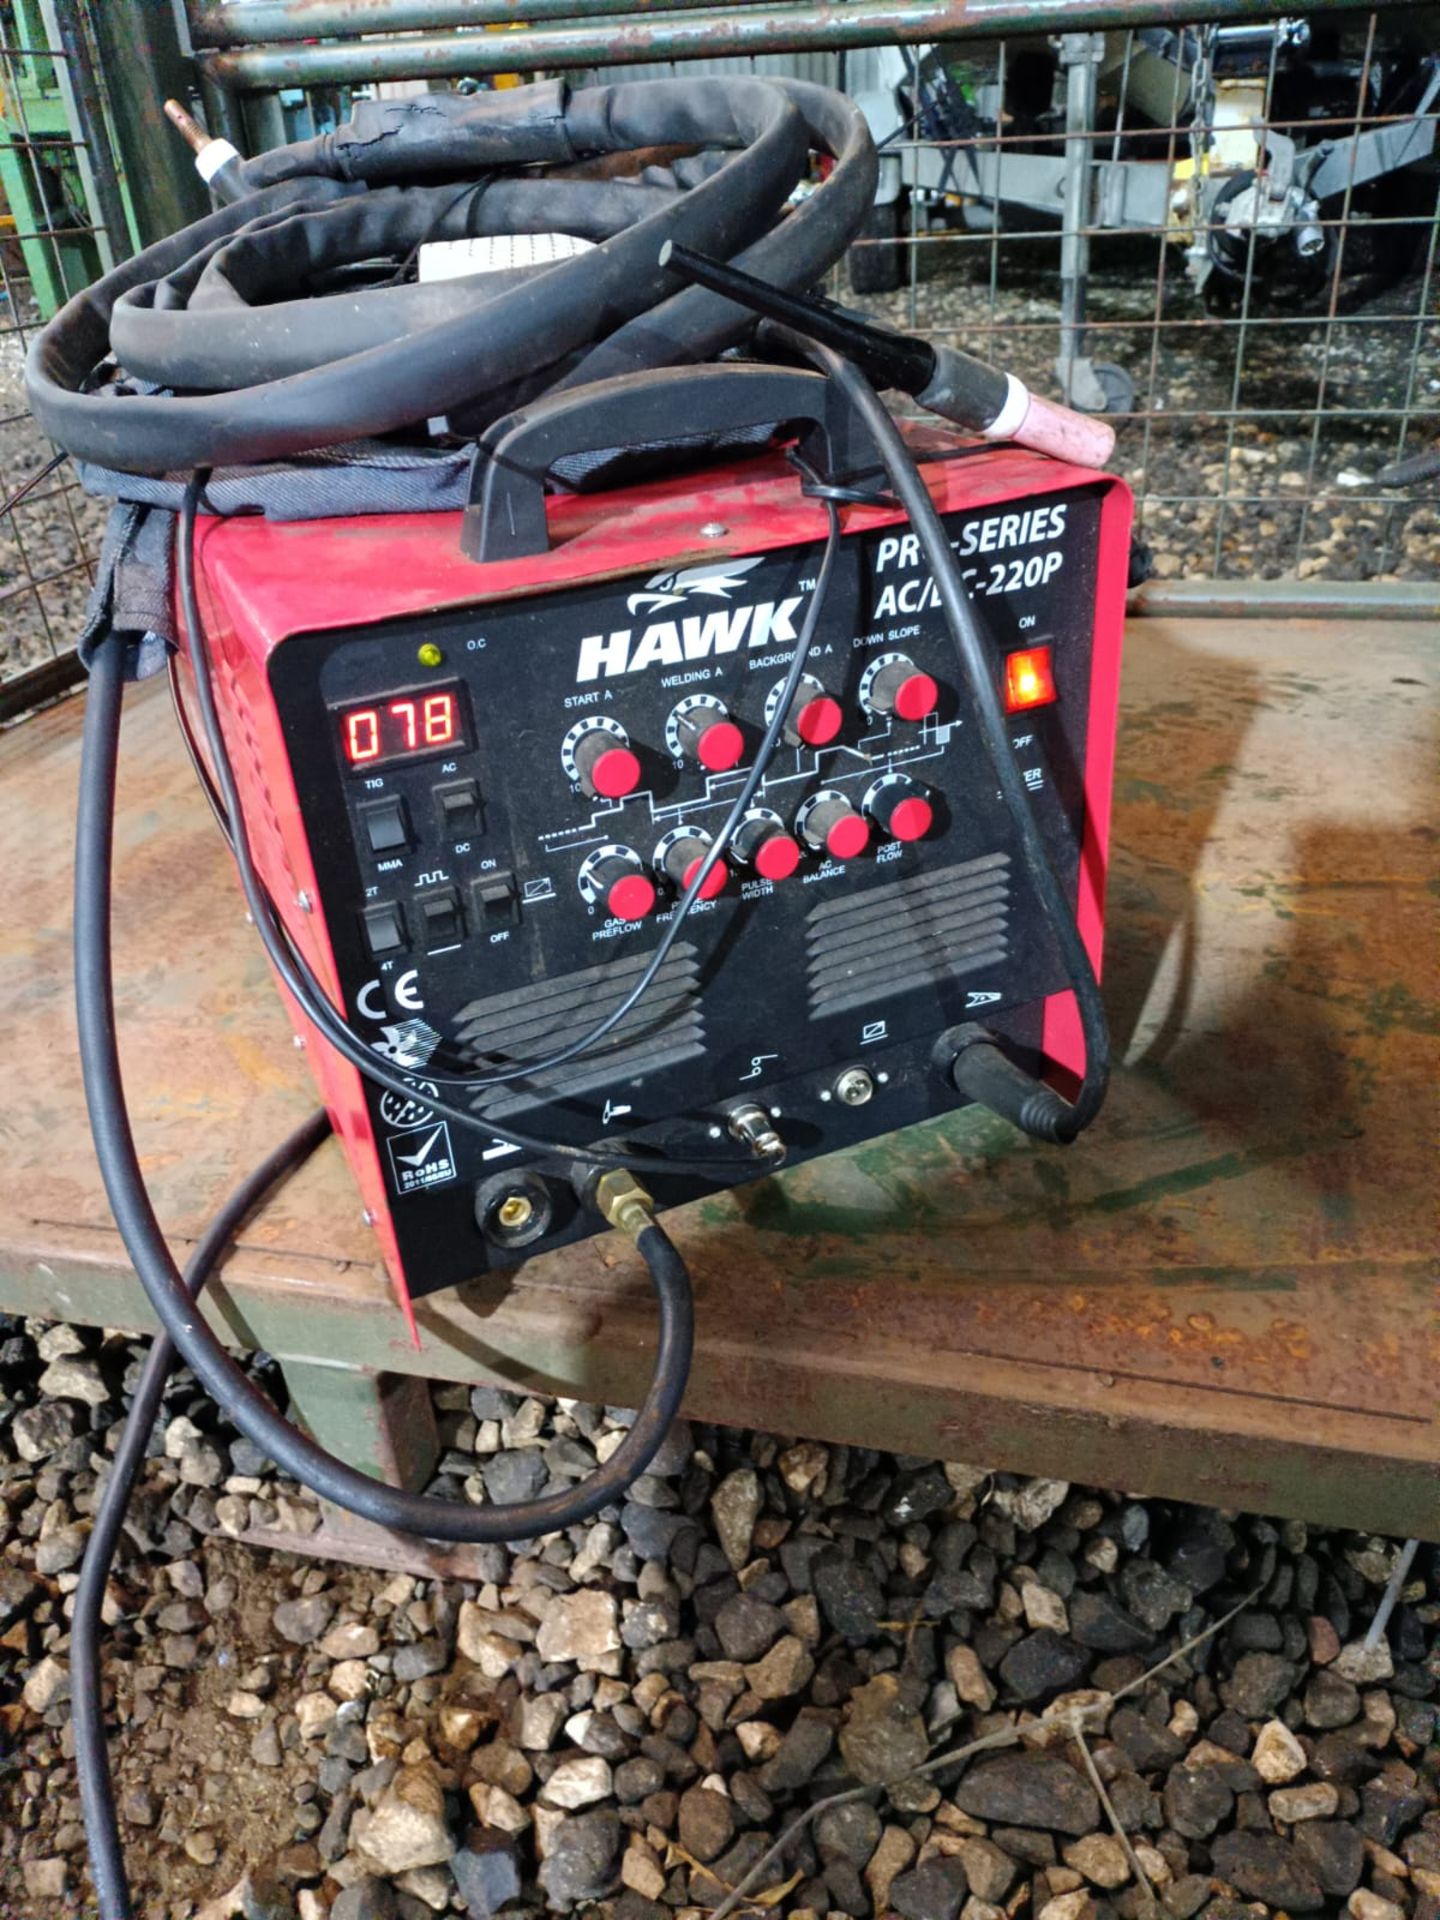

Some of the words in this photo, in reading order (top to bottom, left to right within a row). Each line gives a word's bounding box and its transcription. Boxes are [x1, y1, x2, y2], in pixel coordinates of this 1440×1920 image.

[876, 503, 1067, 573] PR-SERIES
[1018, 615, 1036, 629] ON
[576, 596, 804, 683] HAWK
[798, 578, 816, 592] TM
[853, 633, 884, 648] DOWN
[887, 625, 921, 641] SLOPE
[749, 646, 821, 670] BACKGRND
[824, 644, 833, 654] A
[661, 669, 711, 688] WELDING
[715, 667, 724, 676] A
[564, 692, 600, 709] START
[604, 690, 613, 700] A
[348, 695, 453, 761] 078
[441, 762, 457, 774] AC
[672, 759, 684, 769] 10
[365, 778, 384, 789] TIG
[569, 783, 581, 793] 10
[455, 842, 471, 854] DC
[877, 841, 902, 854] POST
[876, 849, 903, 864] FLOW
[377, 859, 403, 872] MMA
[480, 858, 496, 870] ON
[818, 859, 833, 870] AC
[803, 864, 846, 884] BALANCE
[741, 879, 773, 891] PULSE
[365, 886, 378, 898] 2T
[742, 885, 774, 900] WIDTH
[587, 906, 595, 915] 0
[656, 900, 717, 923] FRENCY
[604, 918, 626, 929] GAS
[592, 920, 643, 941] PREFLOW
[490, 931, 509, 944] OFF
[381, 961, 394, 971] 4T
[356, 969, 425, 1020] CE
[402, 1159, 450, 1182] RoHS
